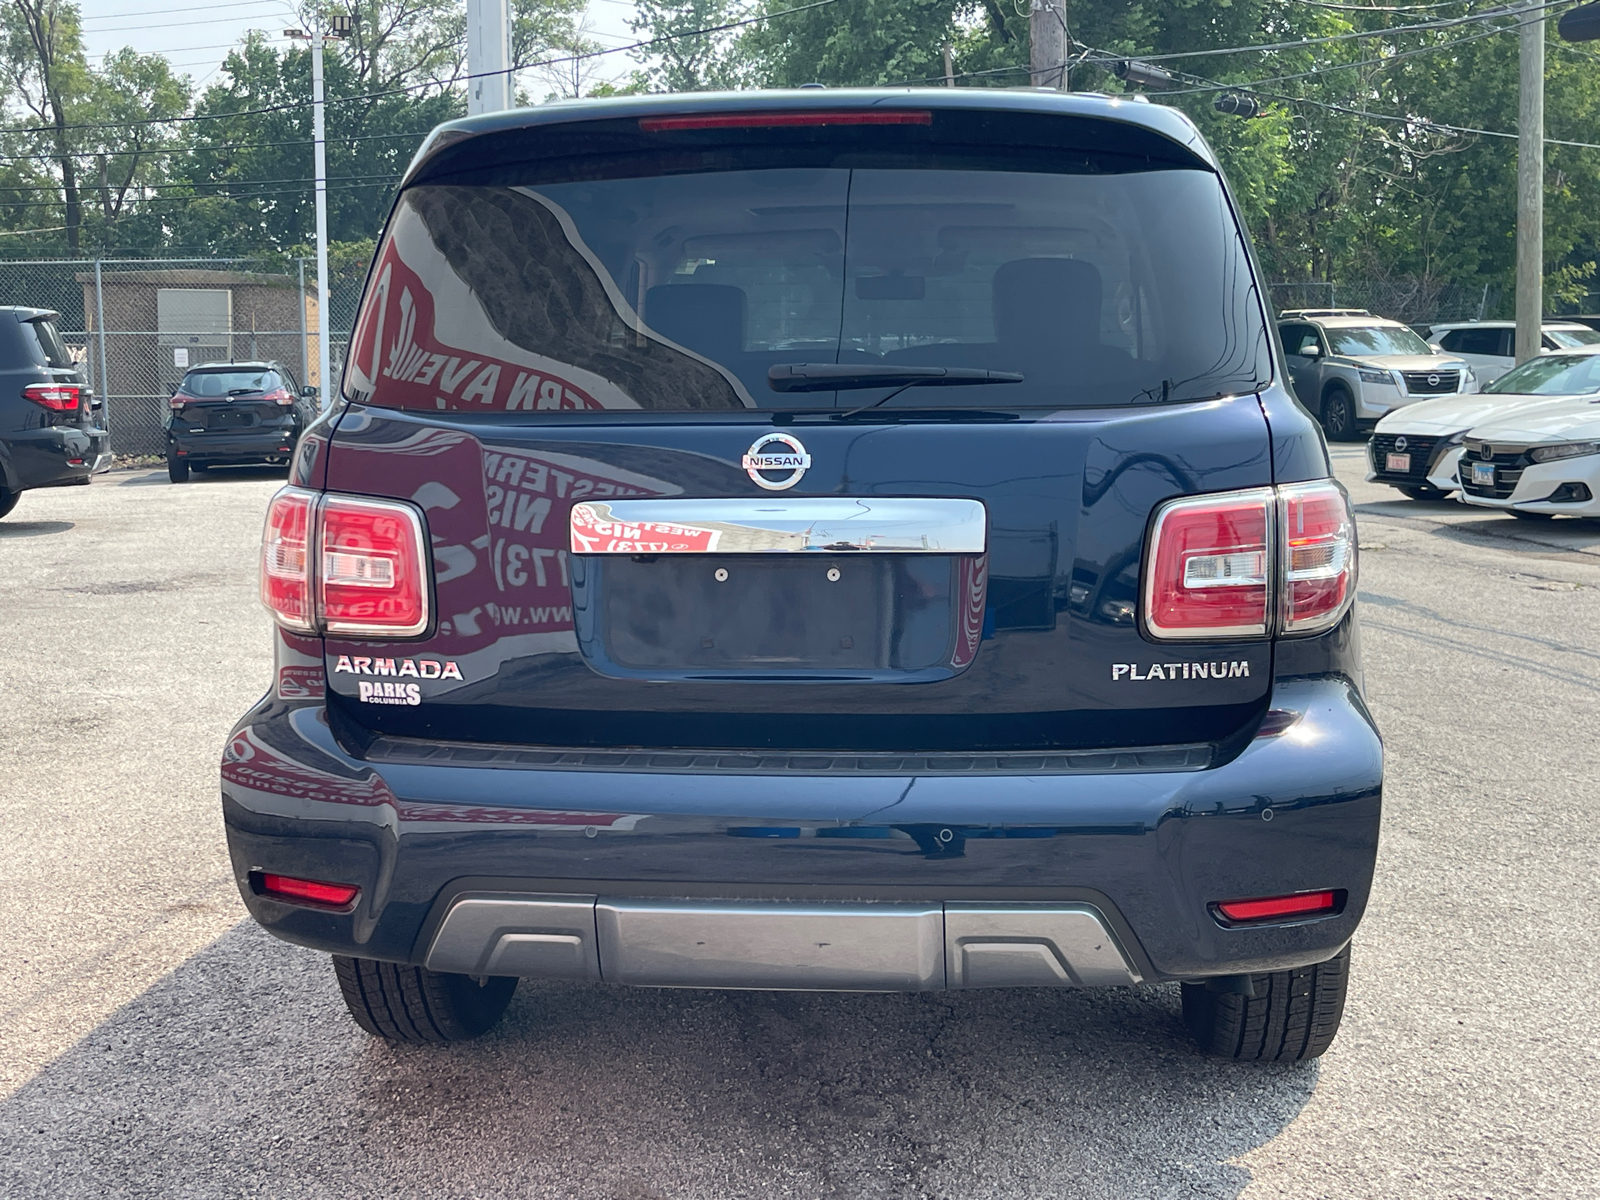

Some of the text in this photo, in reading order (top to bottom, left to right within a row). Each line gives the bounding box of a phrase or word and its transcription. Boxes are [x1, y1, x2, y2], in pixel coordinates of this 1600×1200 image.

[749, 457, 803, 466] NISSAN
[335, 655, 464, 681] ARMADA
[1112, 660, 1250, 681] PLATINUM
[359, 681, 421, 706] PARKS
[369, 696, 408, 705] COLUMBIA
